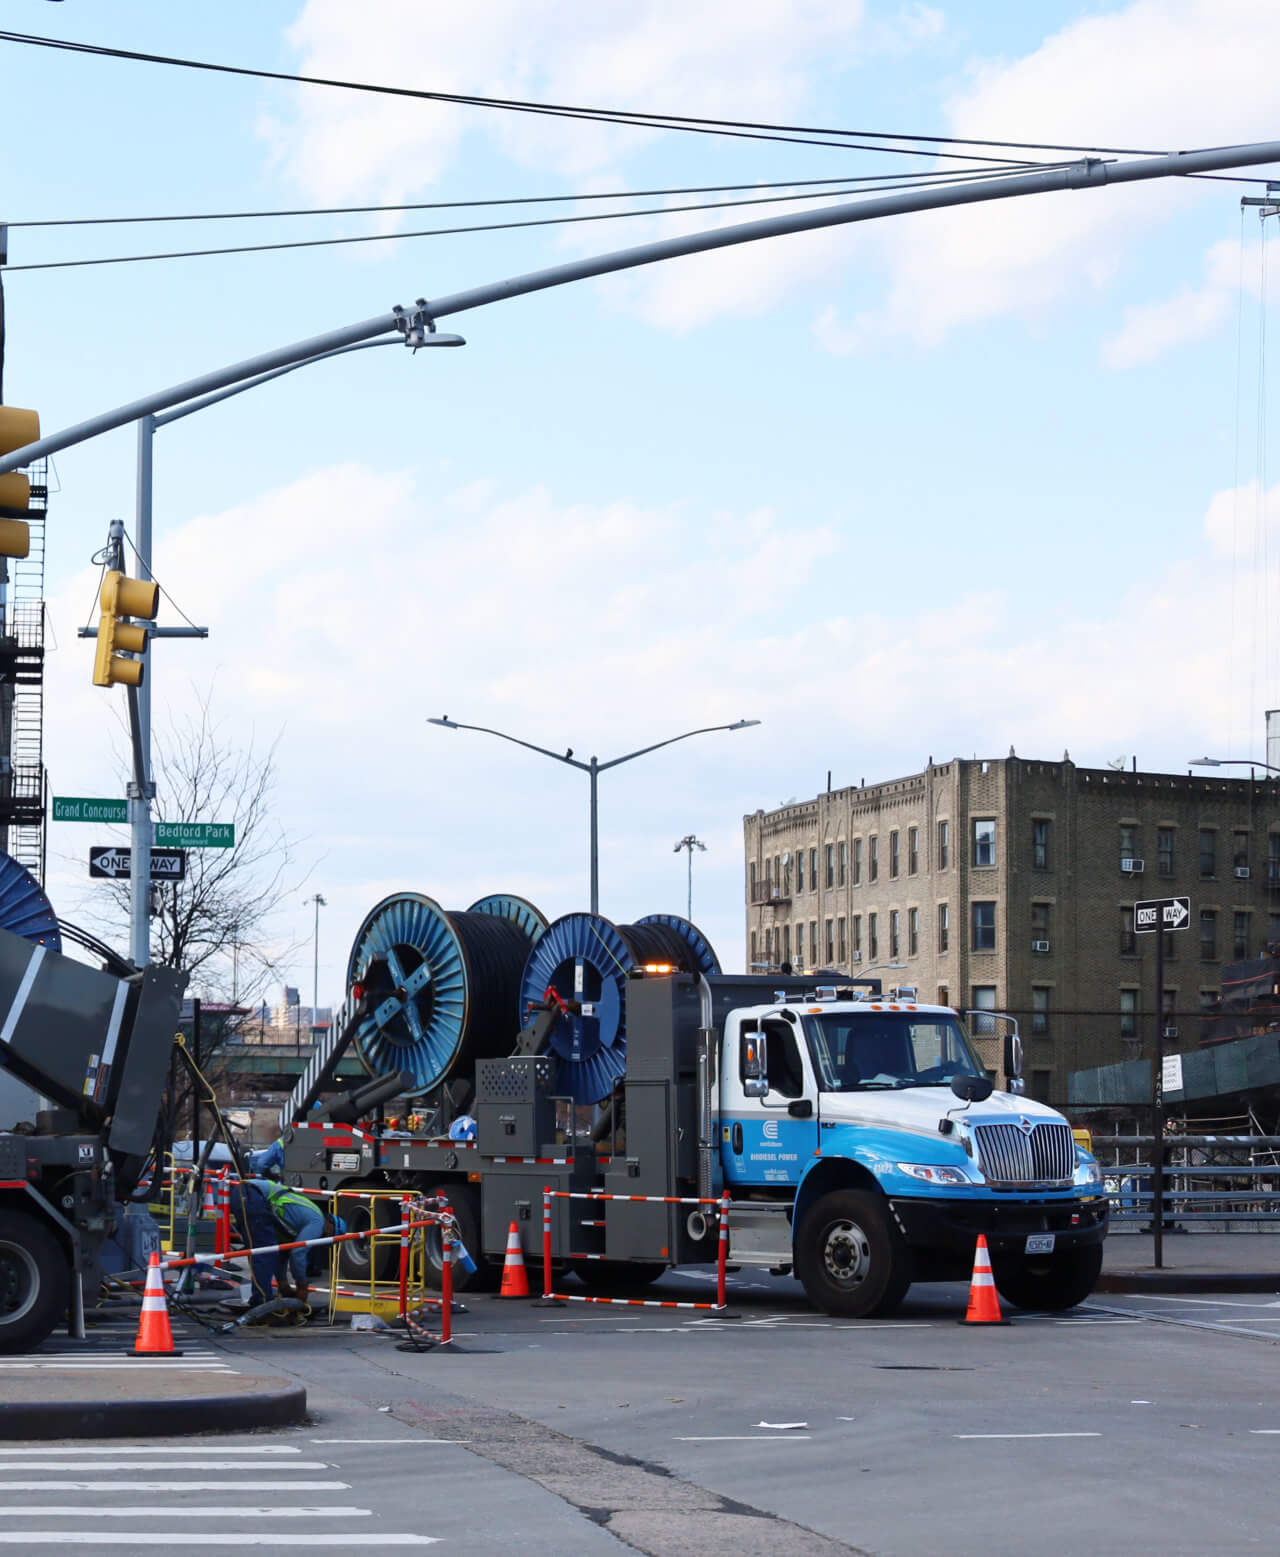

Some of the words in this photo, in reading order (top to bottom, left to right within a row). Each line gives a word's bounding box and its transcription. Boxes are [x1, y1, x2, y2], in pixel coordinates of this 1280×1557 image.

[55, 801, 80, 817] Grand
[83, 802, 126, 819] Concourse
[158, 824, 201, 838] Bedford
[205, 825, 230, 838] Park
[100, 856, 130, 870] ONE
[1140, 910, 1157, 922] ONE
[1166, 908, 1183, 920] WAY
